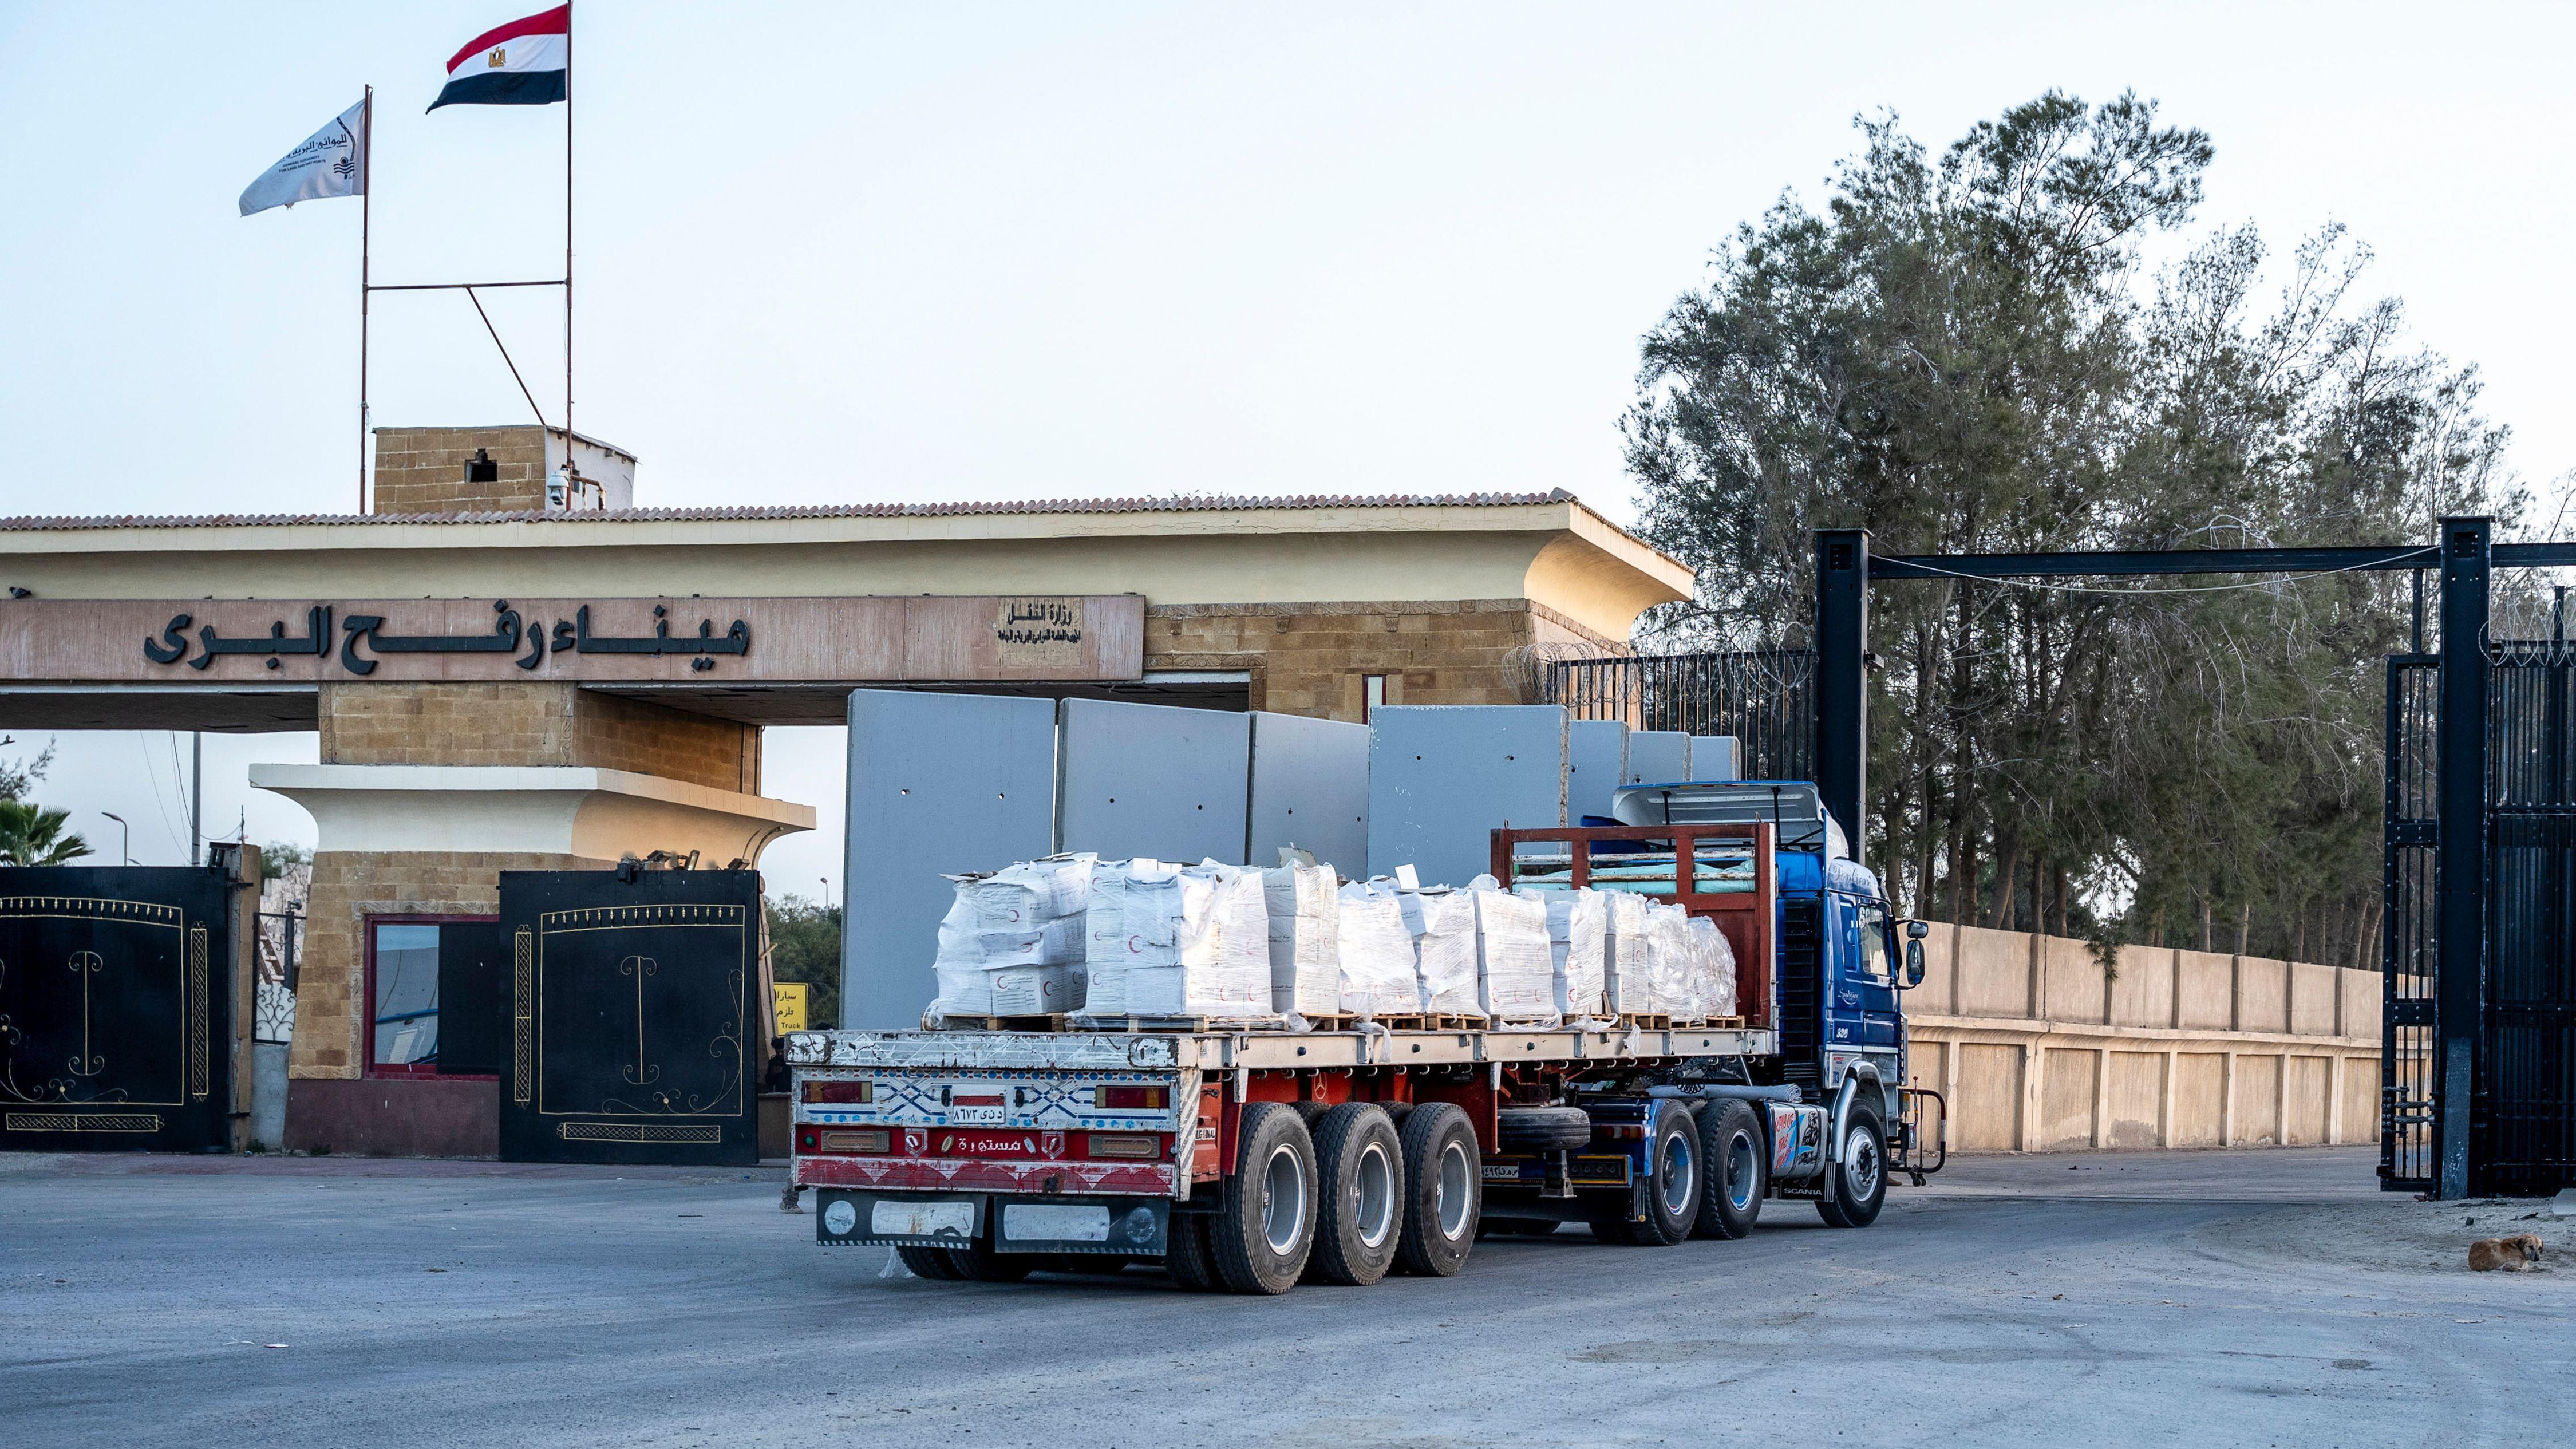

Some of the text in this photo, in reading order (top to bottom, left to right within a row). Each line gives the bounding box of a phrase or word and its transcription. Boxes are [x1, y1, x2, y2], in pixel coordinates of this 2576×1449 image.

[1008, 603, 1072, 626] وزارة النقل
[341, 600, 544, 677] رفح
[551, 604, 751, 672] ميناء
[1784, 1187, 1822, 1196] SCANIA
